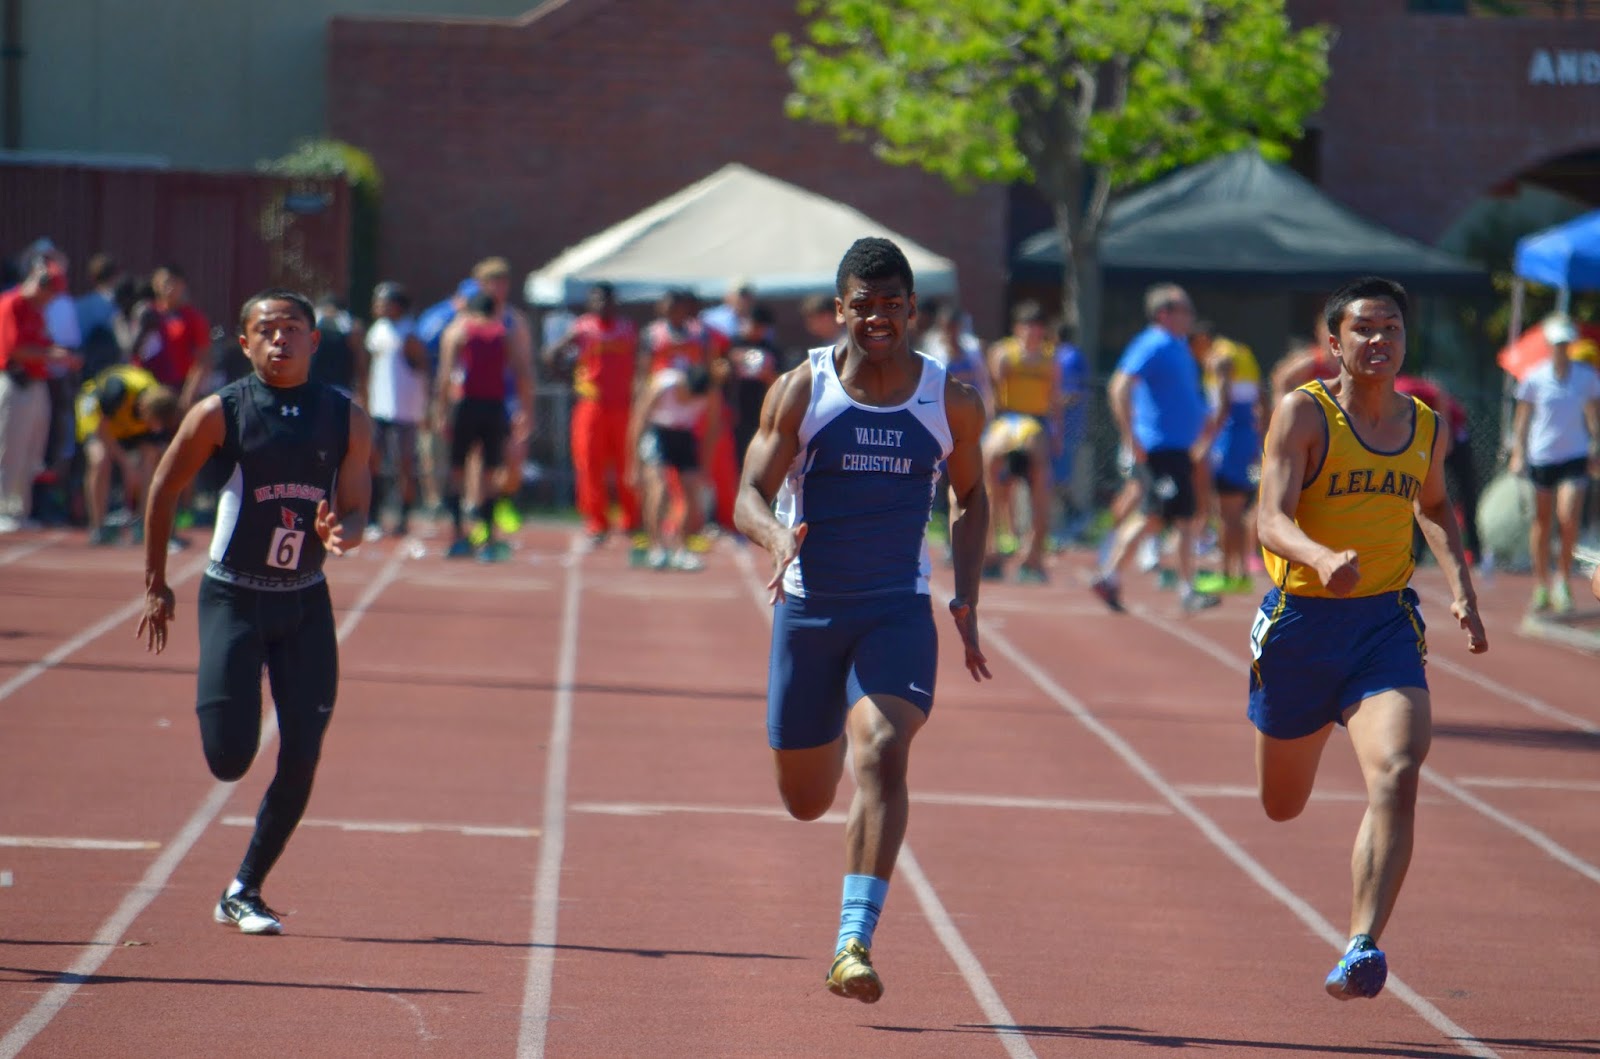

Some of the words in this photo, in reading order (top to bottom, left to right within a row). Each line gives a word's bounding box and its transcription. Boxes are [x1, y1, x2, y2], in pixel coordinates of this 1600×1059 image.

[855, 427, 904, 447] VALLEY
[842, 453, 913, 474] CHRISTIAN
[276, 532, 298, 567] 6
